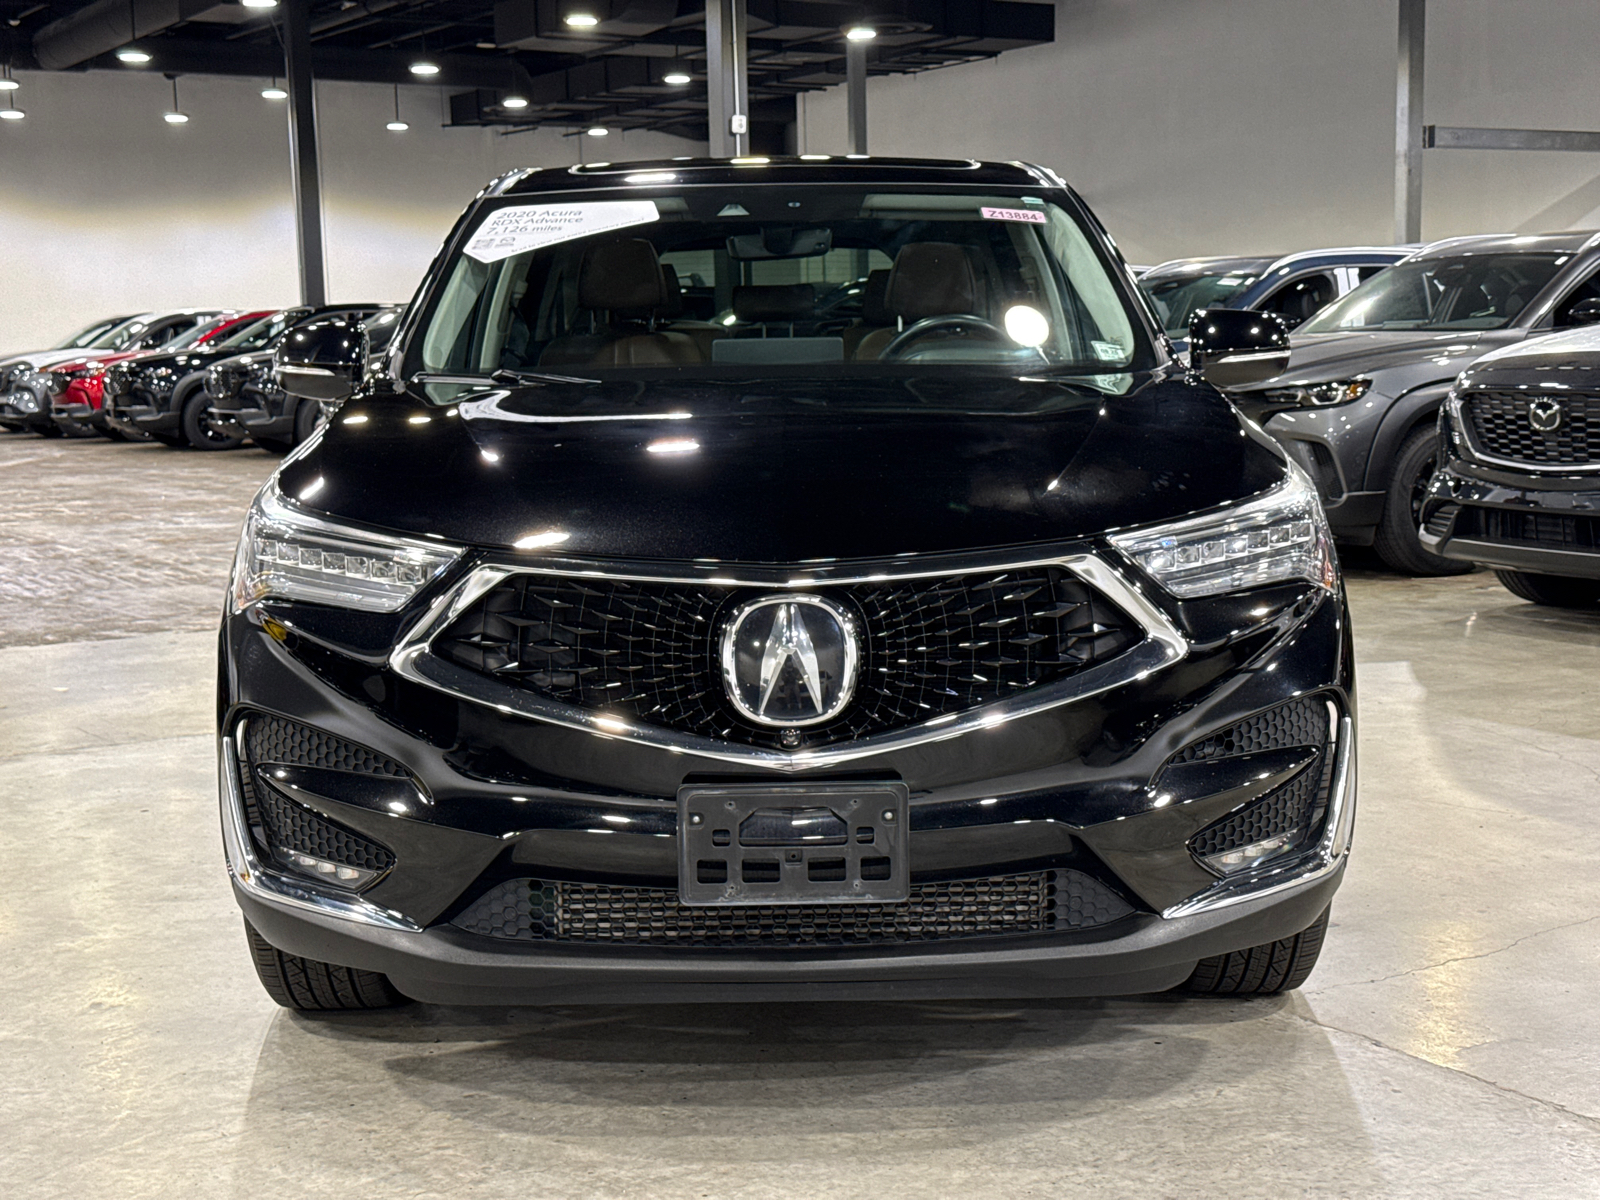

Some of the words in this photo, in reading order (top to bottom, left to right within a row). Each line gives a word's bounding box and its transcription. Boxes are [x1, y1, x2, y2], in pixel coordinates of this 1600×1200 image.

[497, 210, 537, 219] 2020
[988, 210, 1038, 220] Z13884
[492, 218, 522, 226] RDX
[524, 217, 583, 225] Advance
[487, 225, 528, 234] 7,126
